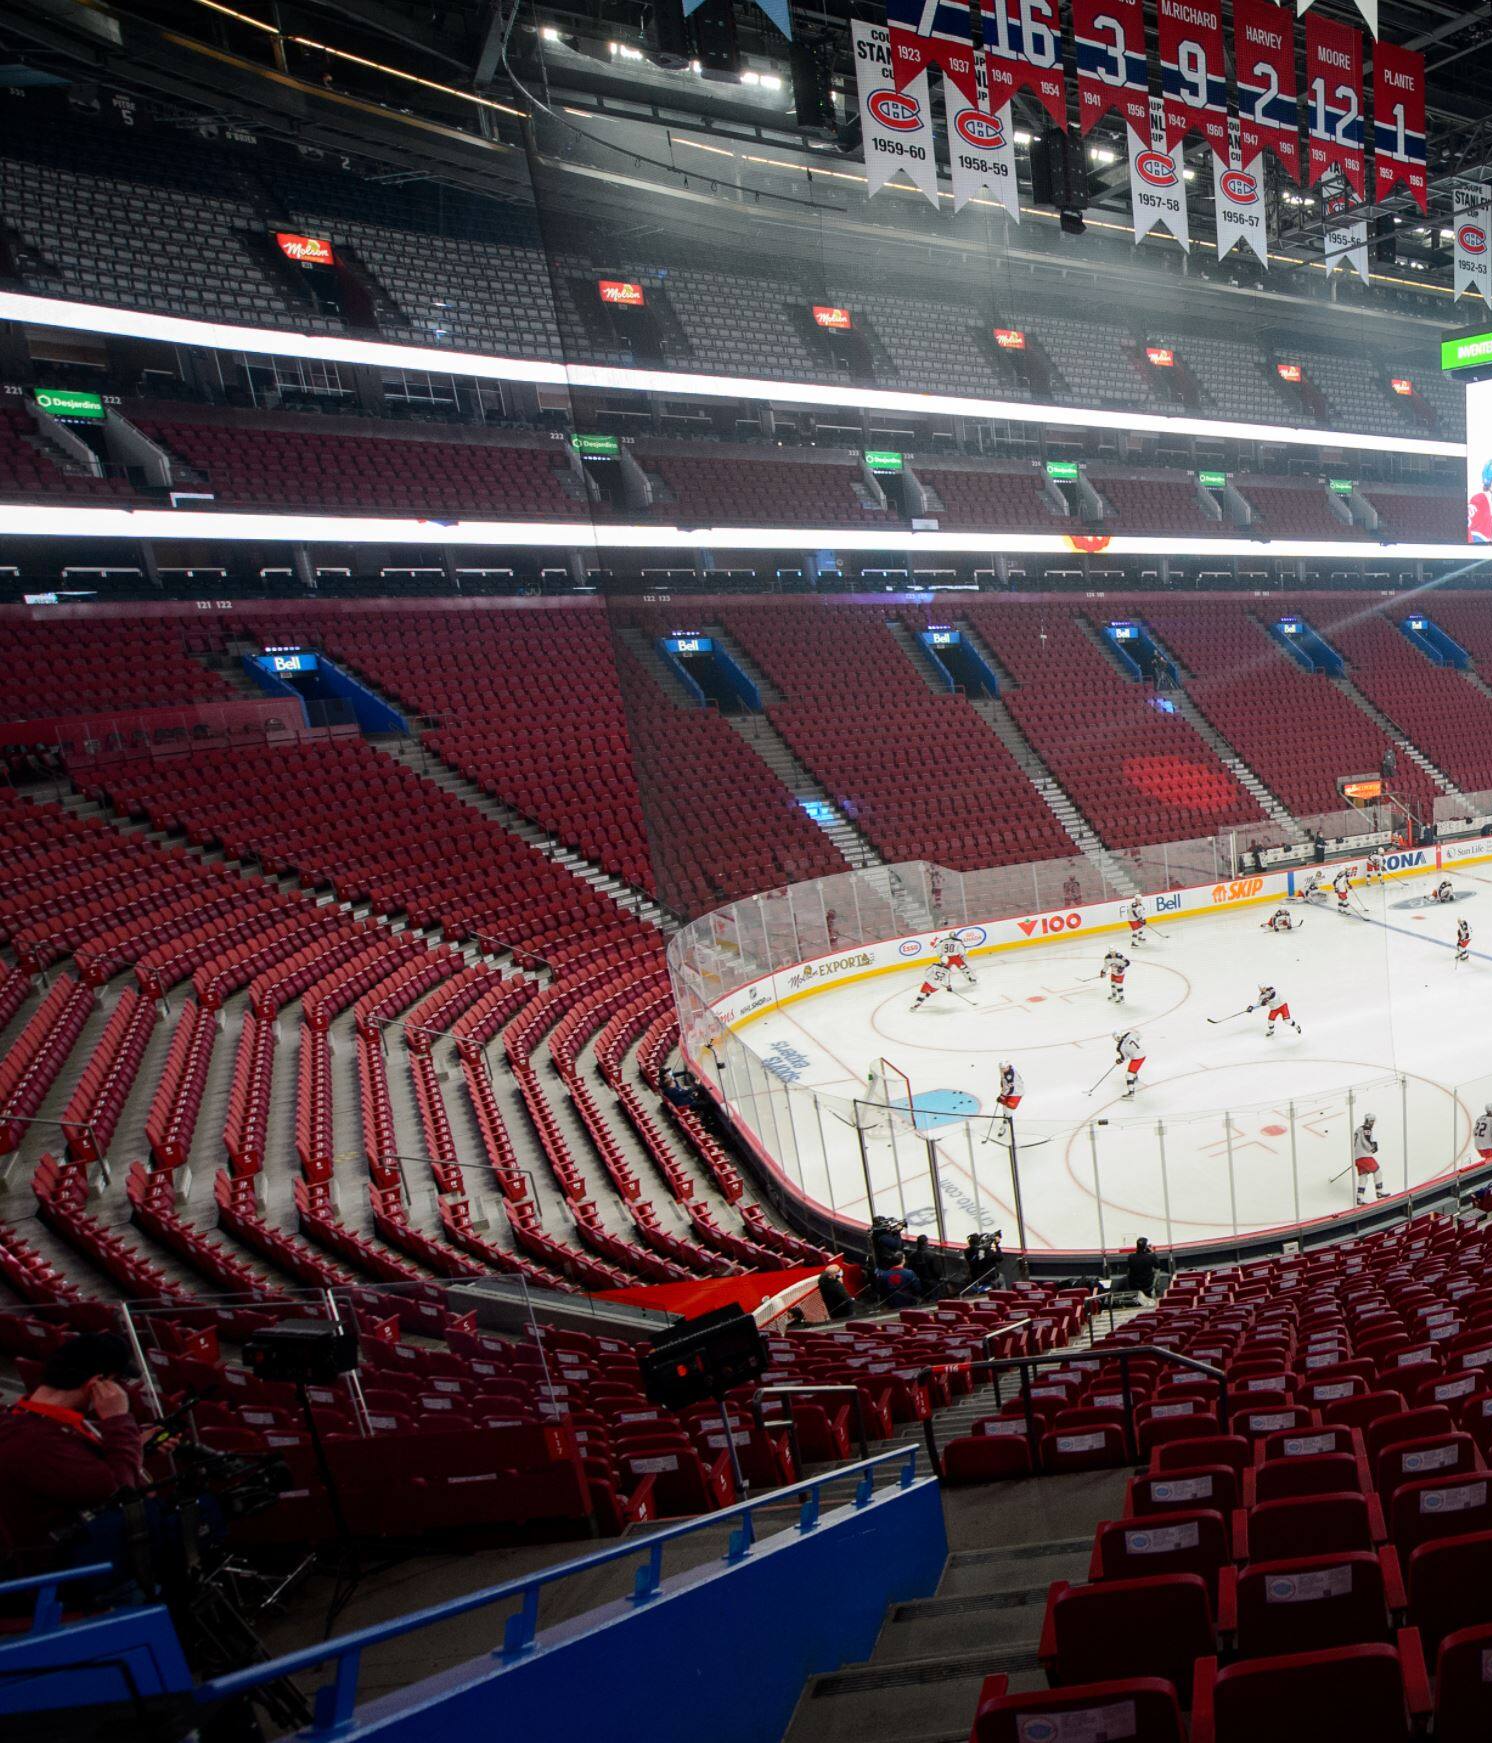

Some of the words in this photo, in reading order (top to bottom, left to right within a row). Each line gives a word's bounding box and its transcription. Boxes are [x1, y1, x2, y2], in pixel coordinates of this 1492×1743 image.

[1161, 1, 1217, 31] M.RICHARD
[990, 0, 1056, 69] 16
[1245, 26, 1283, 50] HARVEY
[897, 44, 921, 62] 1923
[1094, 15, 1127, 87] 3
[1317, 45, 1351, 70] MOORE
[881, 67, 895, 80] CU
[949, 58, 970, 74] 1937
[992, 69, 1013, 85] 1940
[1178, 40, 1207, 109] 9
[1384, 69, 1415, 91] PLANTE
[1040, 81, 1060, 97] 1954
[1253, 62, 1280, 129] 2
[1083, 91, 1101, 107] 1941
[1127, 102, 1145, 118] 1956
[1311, 77, 1360, 150] 12
[1168, 113, 1186, 129] 1942
[1206, 123, 1223, 137] 1960
[1392, 103, 1409, 163] 1
[1243, 132, 1258, 146] 1947
[871, 137, 926, 161] 1959-60
[1279, 142, 1295, 155] 1961
[1311, 148, 1326, 162] 1951
[958, 155, 1009, 178] 1958-59
[1345, 158, 1360, 171] 1963
[1379, 166, 1393, 180] 1952
[1409, 174, 1424, 187] 1963
[1138, 192, 1180, 212] 1957-58
[1222, 210, 1260, 228] 1956-57
[284, 240, 328, 257] Molson
[1458, 259, 1487, 275] 1952-53
[605, 287, 640, 300] Molson
[4, 386, 23, 395] 221
[53, 398, 102, 411] Desjardins
[197, 601, 211, 609] 121
[216, 601, 232, 609] 122
[933, 632, 950, 643] Bell
[1115, 628, 1130, 638] Bell
[678, 639, 699, 651] Bell
[273, 654, 300, 670] Bell
[1457, 847, 1471, 856] Sun
[1471, 844, 1484, 853] Life
[1384, 851, 1426, 872] ONA
[1228, 879, 1264, 899] SKIP
[1156, 894, 1181, 912] Bell
[1042, 913, 1082, 934] 100
[903, 944, 919, 952] Esso
[819, 955, 862, 977] EXPORT
[1130, 1040, 1139, 1049] 7
